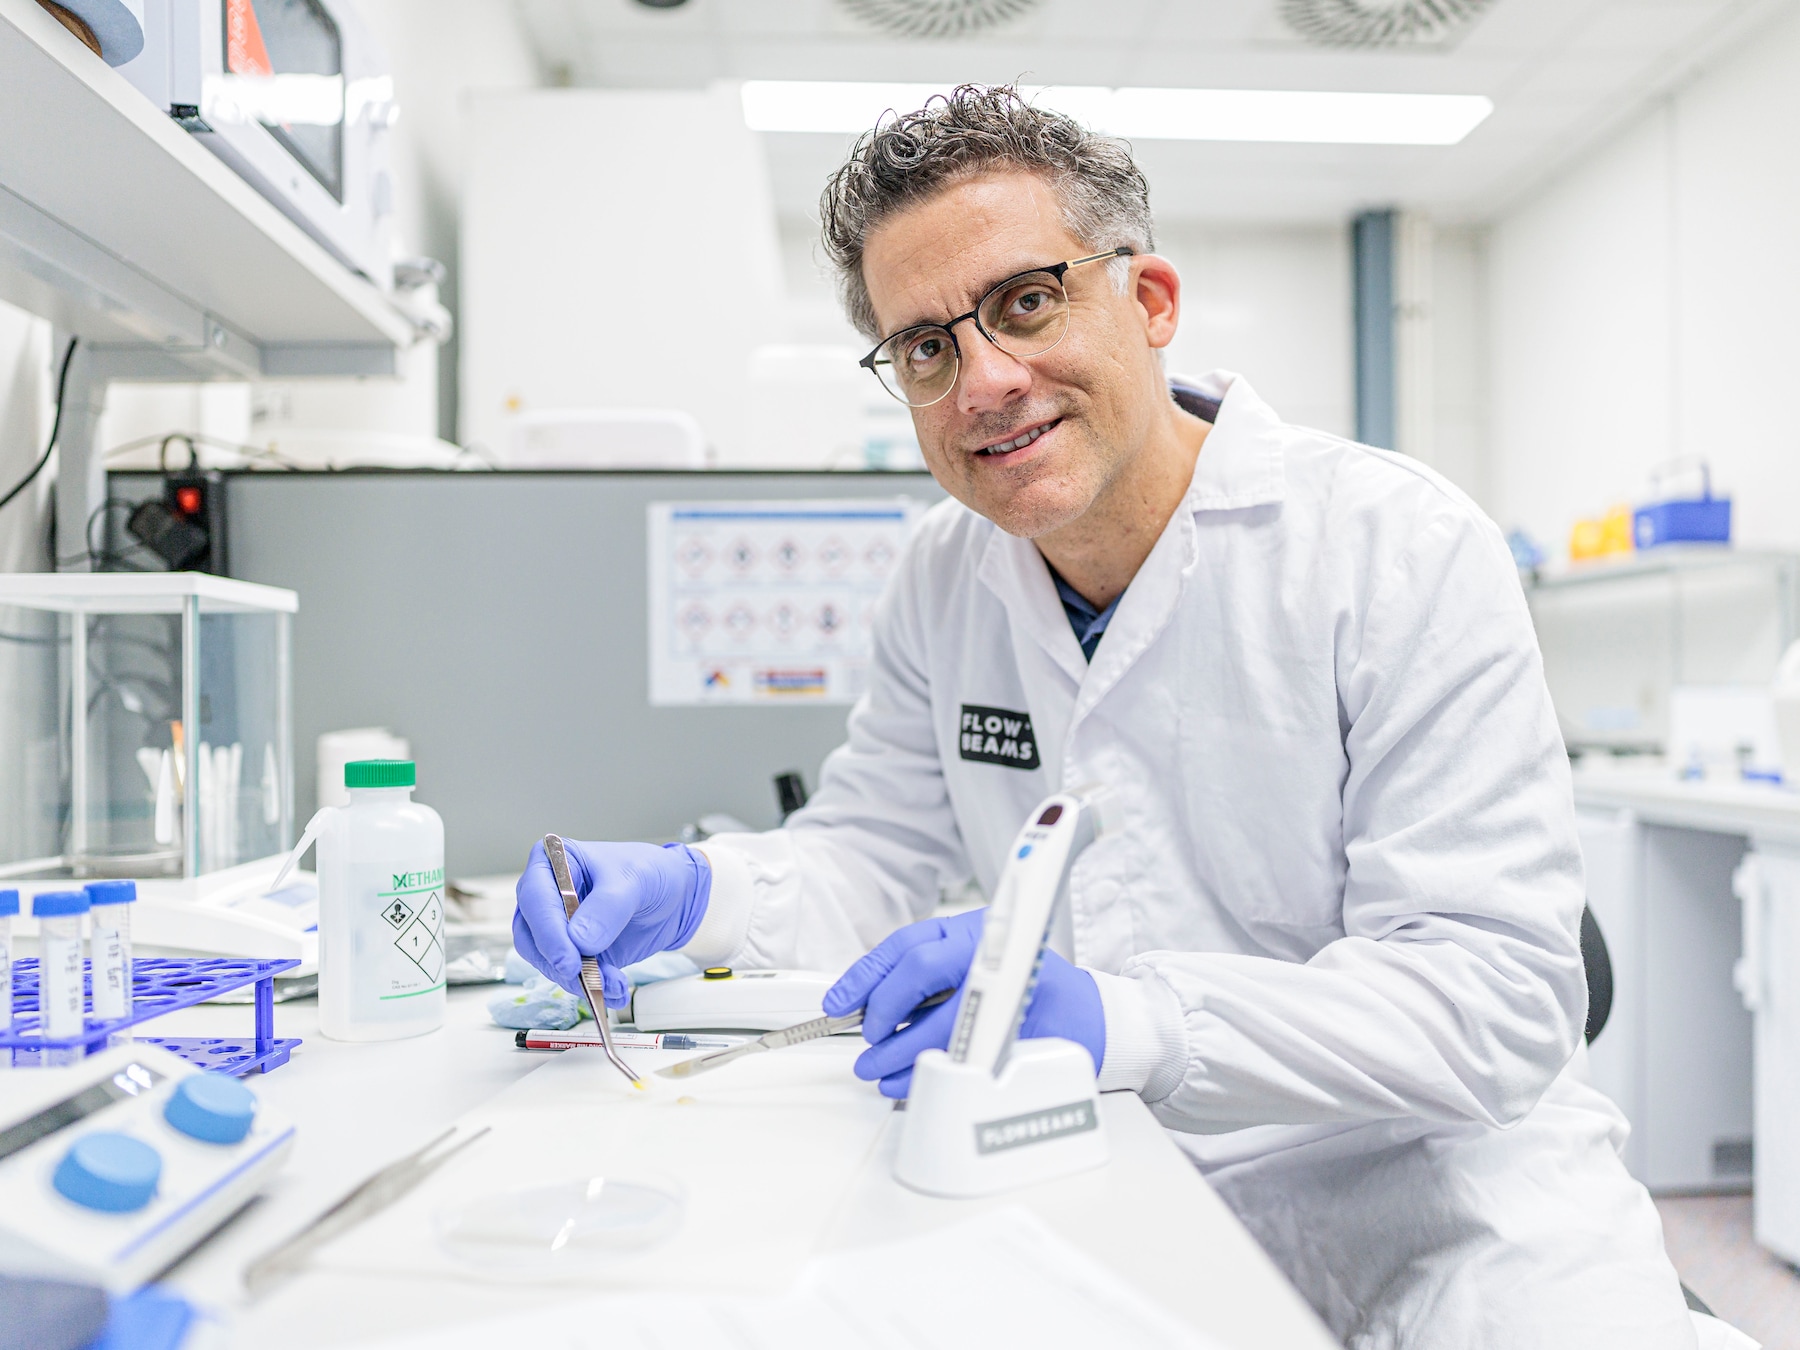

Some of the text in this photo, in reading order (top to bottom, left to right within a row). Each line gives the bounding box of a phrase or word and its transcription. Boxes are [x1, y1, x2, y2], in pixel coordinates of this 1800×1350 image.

[962, 713, 1022, 738] FLOW
[961, 732, 1033, 761] BEAMS
[431, 909, 437, 920] 3
[412, 935, 418, 947] 1
